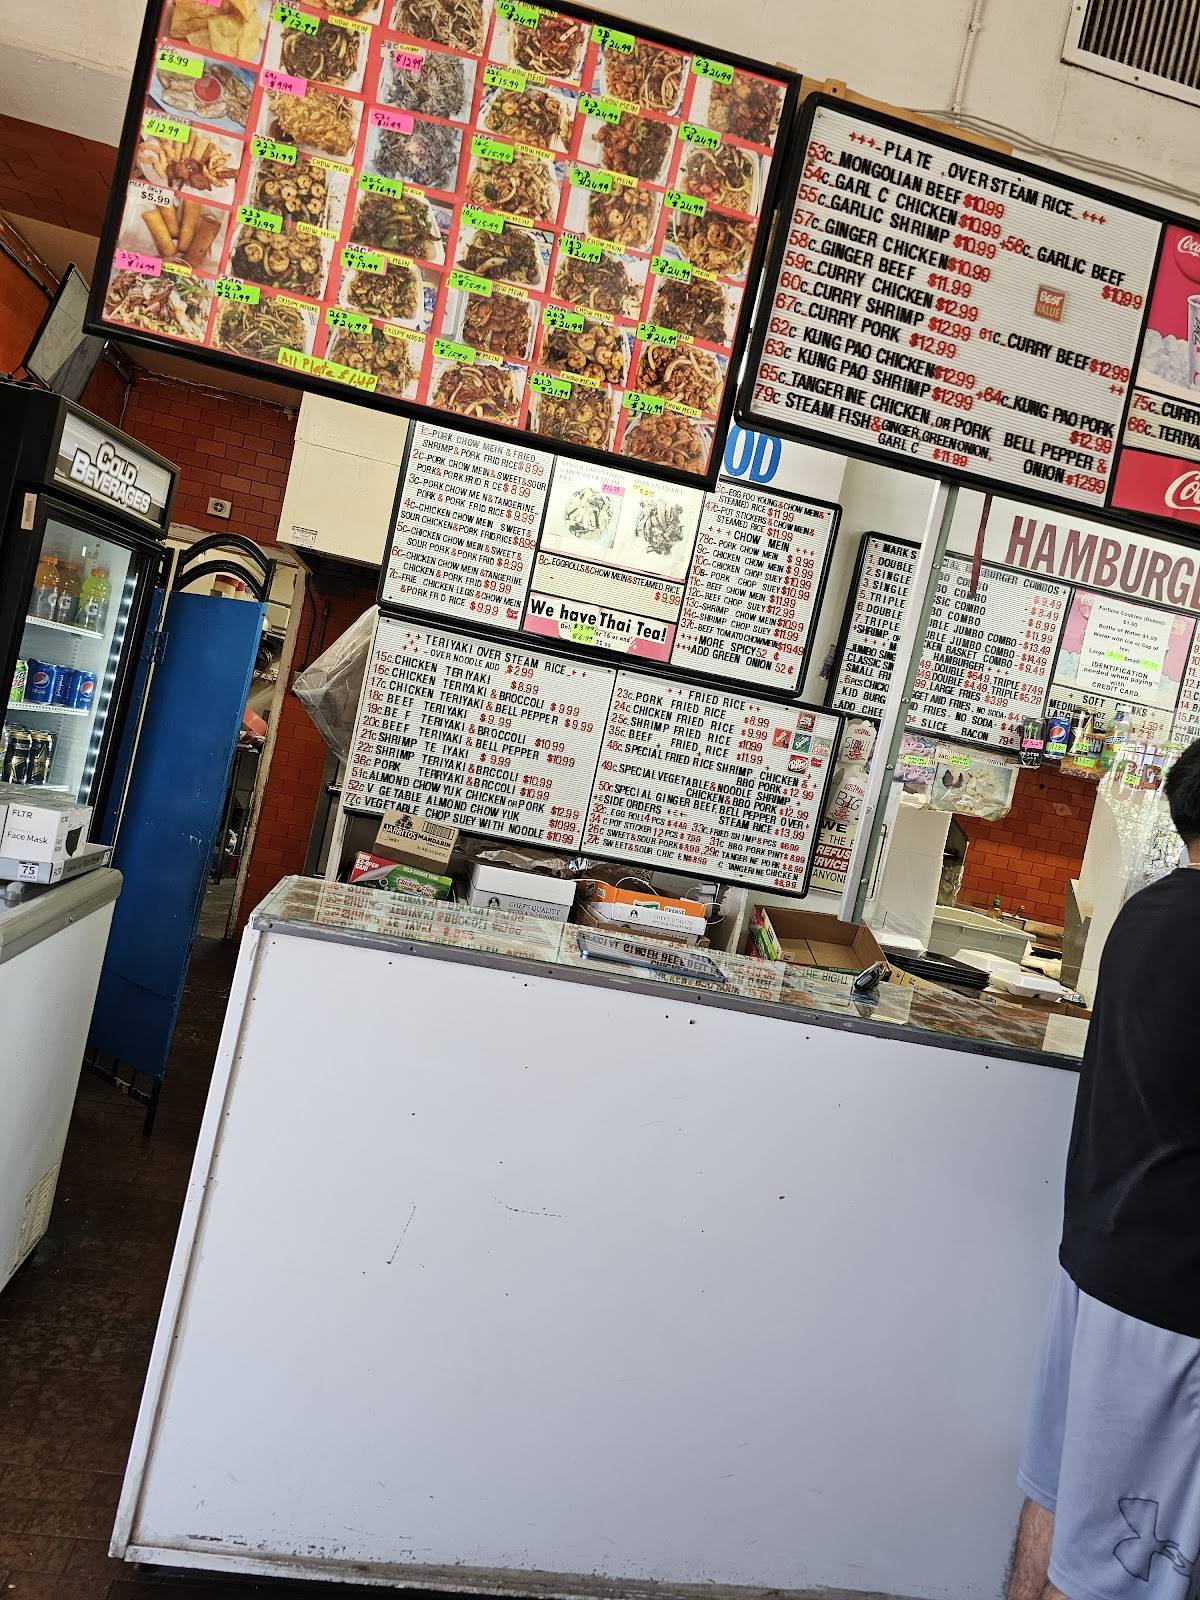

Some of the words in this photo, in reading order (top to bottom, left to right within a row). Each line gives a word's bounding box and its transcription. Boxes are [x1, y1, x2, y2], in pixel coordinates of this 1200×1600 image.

[140, 190, 170, 206] $5.99
[924, 179, 962, 205] BEEF
[989, 175, 1039, 206] STEAM
[894, 192, 958, 226] CHICKEN
[888, 212, 950, 246] SHRIMP
[881, 235, 949, 270] CHICKEN
[877, 256, 916, 282] BEEF
[1035, 245, 1087, 275] GARLIC
[1090, 263, 1126, 288] BEEF
[870, 276, 934, 309] CHICKEN
[864, 296, 925, 329] SHRIMP
[1035, 302, 1061, 319] VALUE
[860, 317, 901, 343] PORK
[908, 331, 957, 360] $12.99
[801, 326, 843, 352] KUNG
[843, 338, 872, 360] PAO
[874, 347, 936, 379] CHICKEN
[1054, 347, 1090, 372] BEEF
[796, 346, 838, 372] KUNG
[838, 358, 868, 381] PAO
[871, 368, 931, 399] SHRIMP
[1051, 406, 1079, 428] PAO
[1078, 414, 1115, 438] PORK
[783, 390, 836, 420] STEAM
[1021, 457, 1065, 484] ONION
[951, 416, 992, 442] PORK
[1002, 431, 1038, 455] BELL
[1039, 441, 1094, 471] PEPPER
[96, 442, 138, 487] COLD
[69, 447, 152, 515] BEVERAGES
[451, 510, 474, 523] CHOW
[733, 530, 761, 545] CHOW
[767, 538, 790, 551] MEIN
[739, 544, 760, 556] CHOW
[712, 549, 740, 562] CHICKEN
[743, 556, 764, 568] CHOW
[877, 556, 914, 573] DOUBLE
[874, 568, 911, 585] SINGLE
[531, 598, 555, 617] We
[560, 604, 597, 625] have
[599, 612, 632, 634] Thai
[636, 621, 667, 642] Tea!
[869, 592, 906, 608] TRIPLE
[946, 610, 981, 627] COMBO
[954, 600, 986, 615] COMBO
[952, 624, 984, 639] JUMBO
[986, 632, 1017, 647] COMBO
[424, 634, 473, 654] TERIYAKI
[476, 645, 502, 661] OVER
[503, 652, 539, 669] STEAM
[711, 648, 740, 663] GREEN
[744, 656, 772, 670] ONION
[932, 652, 984, 672] HAMBURGER
[945, 645, 977, 660] BASKET
[445, 665, 491, 684] TERIYAKI
[509, 679, 540, 695] $8.99
[385, 693, 415, 708] BEEF
[423, 701, 468, 719] TERIYAKI
[387, 680, 434, 699] CHICKEN
[438, 691, 484, 710] TERIYAKI
[494, 703, 519, 717] BELL
[520, 708, 559, 725] PEPPER
[442, 678, 487, 697] TERIYAKI
[498, 690, 545, 709] BROCCOLI
[687, 690, 719, 705] FRIED
[721, 697, 746, 711] RICE
[958, 689, 981, 702] FRIES
[1082, 694, 1106, 708] SOFT
[632, 704, 672, 721] CHICKEN
[675, 713, 704, 728] FRIED
[709, 720, 735, 734] RICE
[740, 726, 768, 741] $9.99
[670, 699, 699, 714] FRIED
[703, 706, 726, 719] RICE
[743, 714, 770, 728] $8.99
[672, 725, 702, 740] FRIED
[707, 732, 731, 746] RICE
[920, 718, 948, 732] SLICE
[960, 727, 989, 741] BACON
[624, 743, 664, 760] SPECIAL
[715, 762, 753, 778] SHRIMP
[759, 771, 799, 788] CHICKEN
[412, 778, 440, 793] CHOW
[441, 784, 462, 797] YUK
[464, 788, 507, 806] CHICKEN
[11, 808, 33, 819] FLTR
[425, 794, 467, 811] ALMOND
[469, 802, 500, 817] CHOW
[500, 808, 520, 821] YUK
[625, 798, 662, 815] ORDERS
[654, 791, 691, 808] GINGER
[742, 809, 777, 826] PEPPER
[778, 806, 809, 821] $12.99
[383, 822, 418, 841] JARRITOS
[417, 833, 452, 849] MANDARIN
[424, 807, 450, 821] CHOP
[452, 812, 476, 826] SUEY
[478, 817, 505, 831] WITH
[508, 823, 544, 839] NOODLE
[717, 815, 749, 830] STEAM
[6, 829, 26, 842] Face
[26, 833, 49, 845] Mask
[829, 834, 847, 846] THE
[22, 864, 36, 876] 75
